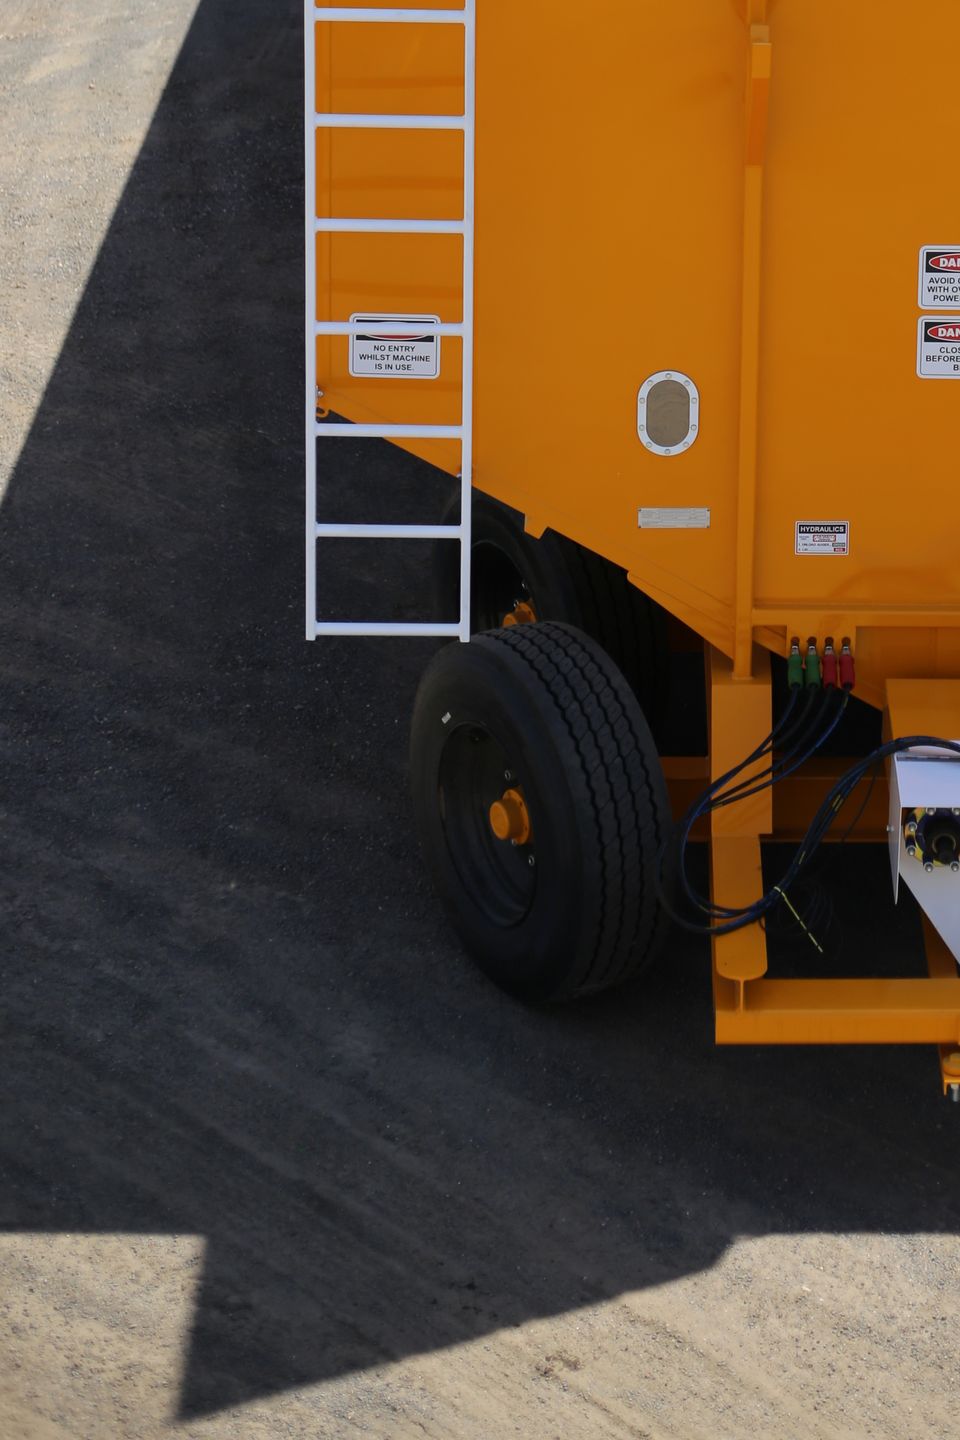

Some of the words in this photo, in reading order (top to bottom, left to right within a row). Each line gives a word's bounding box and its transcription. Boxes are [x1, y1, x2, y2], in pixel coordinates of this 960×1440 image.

[929, 277, 955, 285] AVOID
[359, 353, 390, 361] WHILST
[392, 354, 431, 362] MACHINE
